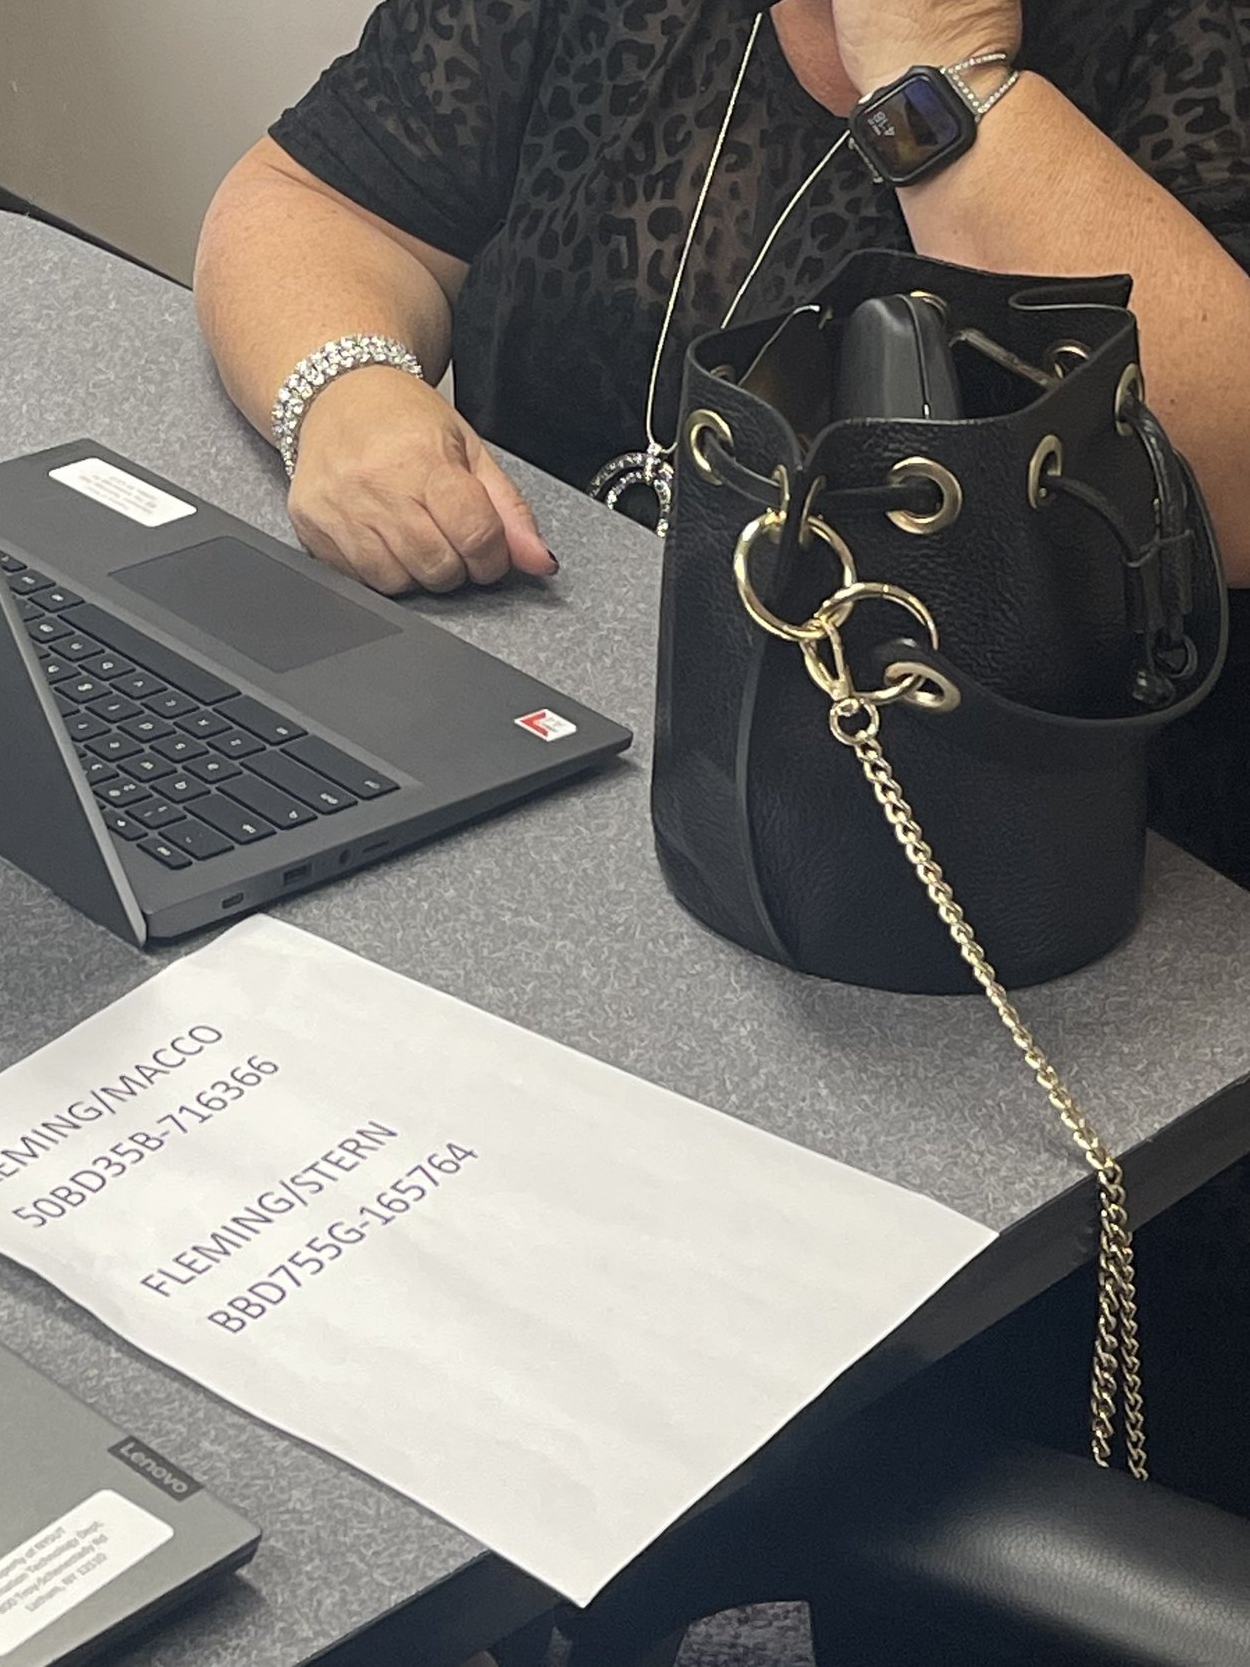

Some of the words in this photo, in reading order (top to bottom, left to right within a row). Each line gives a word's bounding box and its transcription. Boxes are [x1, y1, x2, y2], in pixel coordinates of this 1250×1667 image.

[12, 1055, 280, 1228] 50BD35B-716366
[140, 1121, 398, 1298] FLEMING/STERN
[207, 1143, 478, 1333] BBD755G-165764
